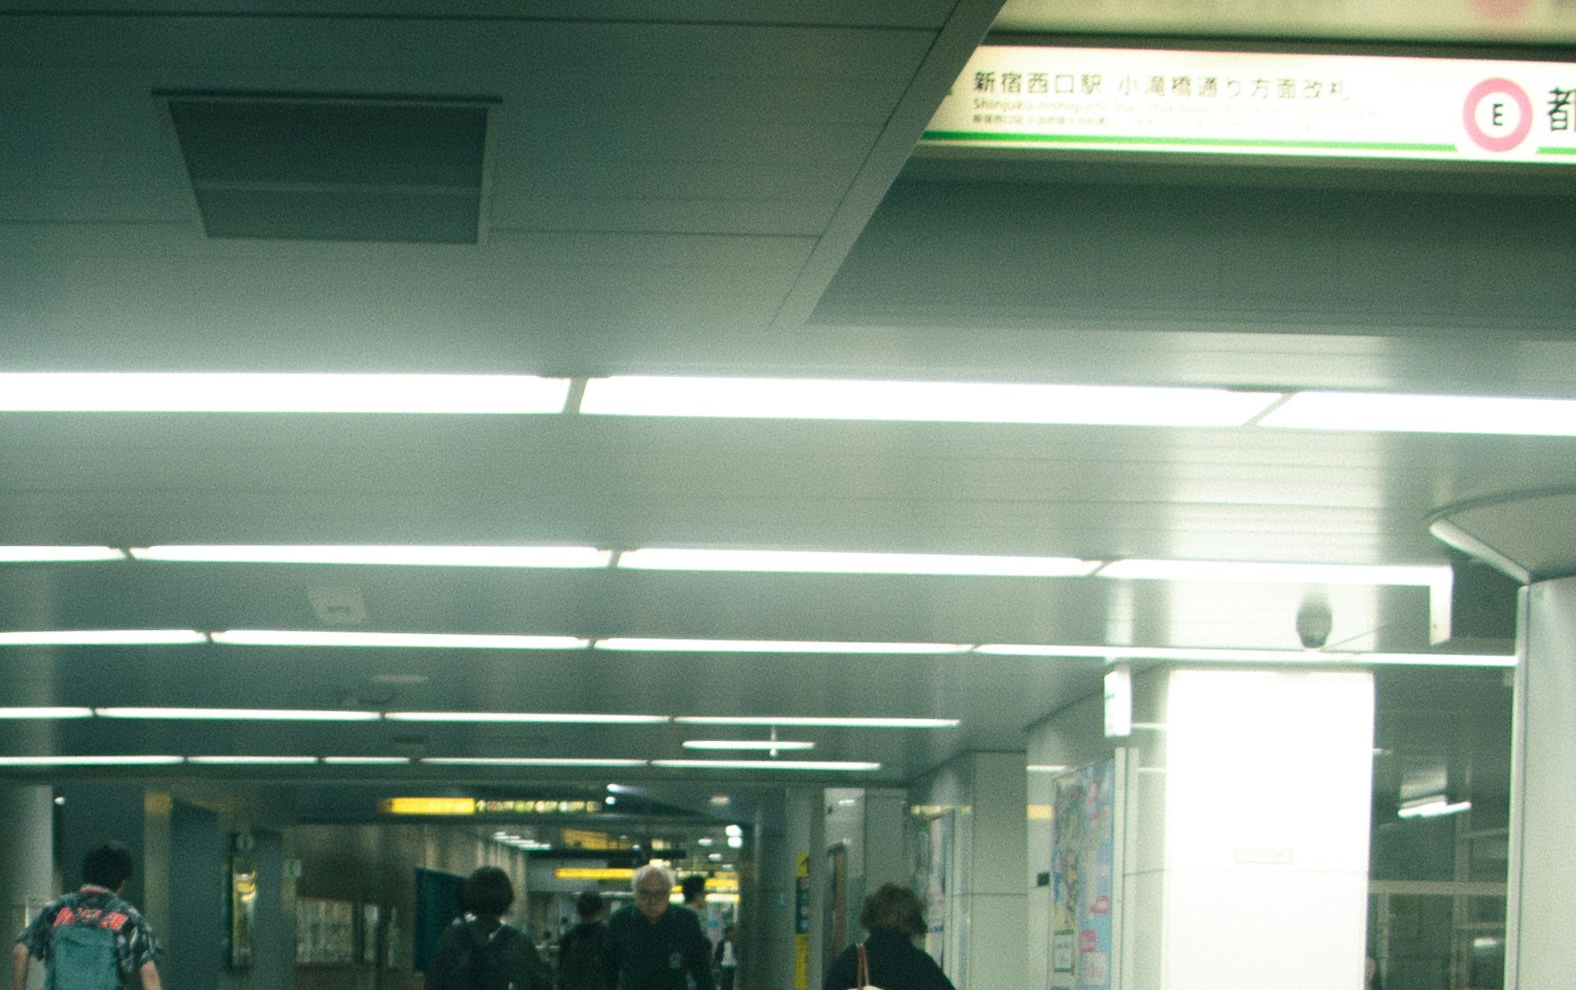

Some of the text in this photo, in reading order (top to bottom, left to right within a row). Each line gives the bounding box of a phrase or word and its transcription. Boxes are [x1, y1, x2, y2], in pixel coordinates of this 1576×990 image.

[973, 71, 1351, 101] 新宿西口駅 小滝橋通り方面改札
[1489, 104, 1506, 127] E
